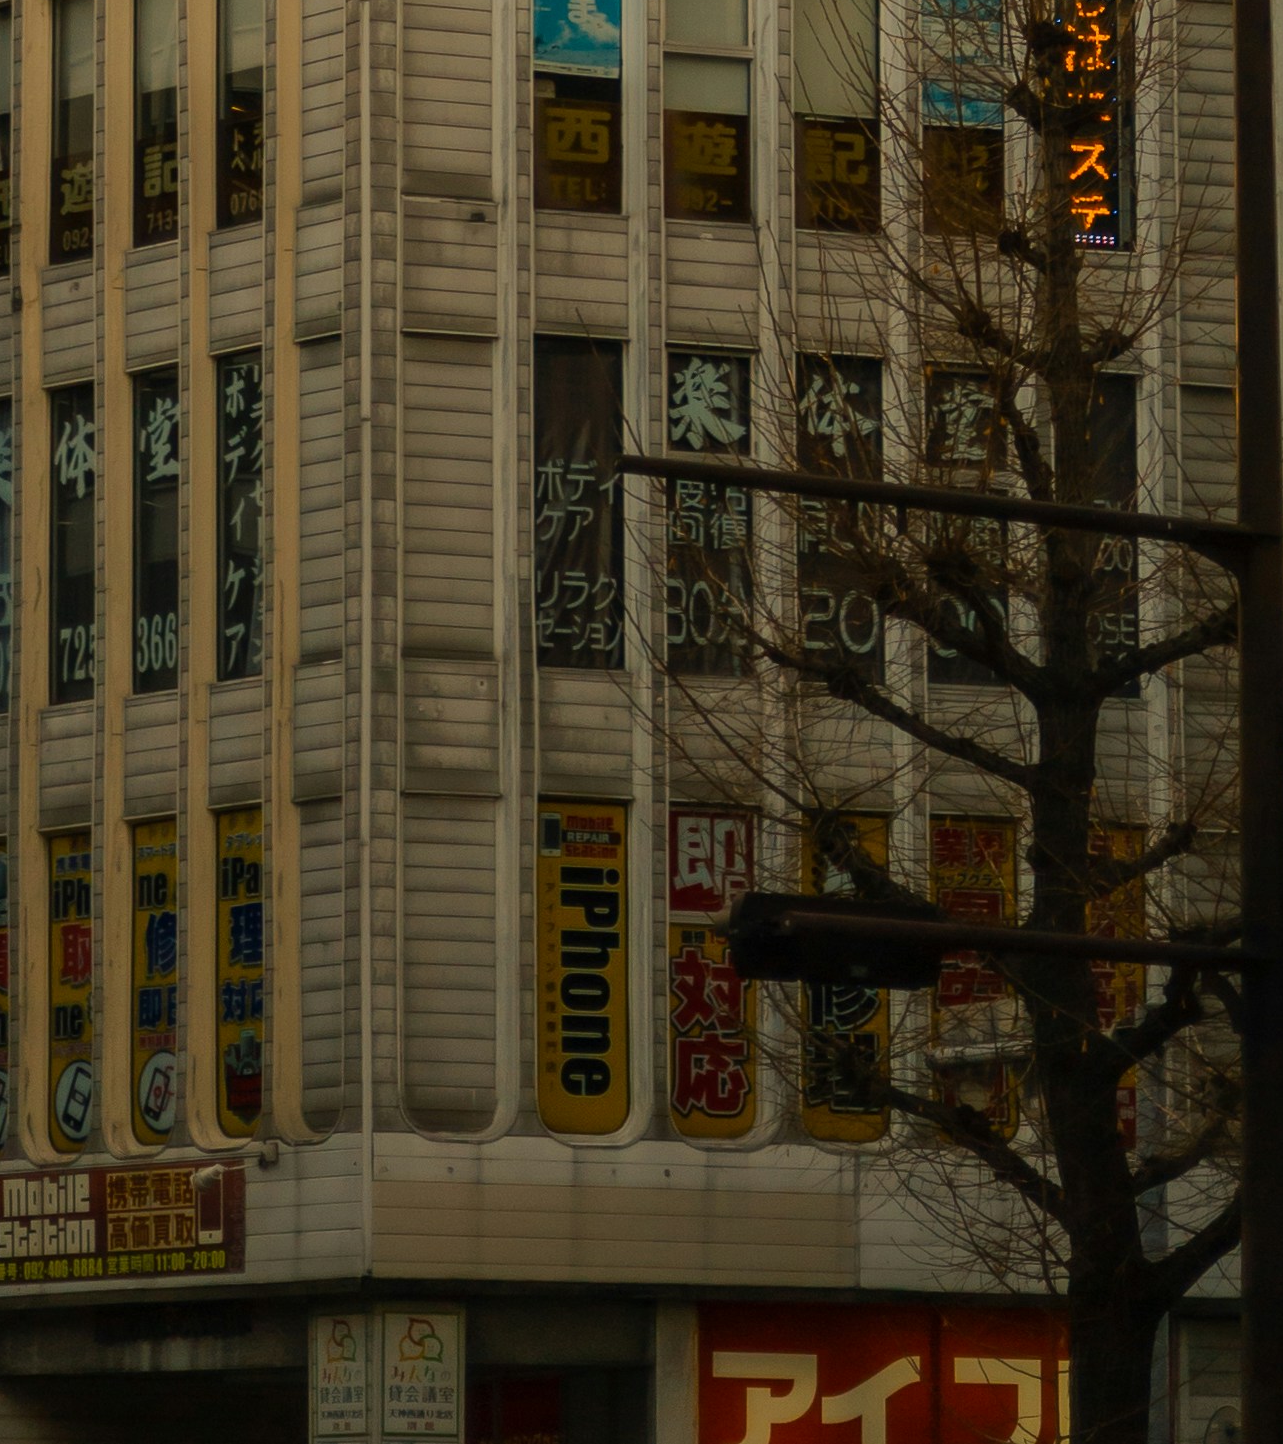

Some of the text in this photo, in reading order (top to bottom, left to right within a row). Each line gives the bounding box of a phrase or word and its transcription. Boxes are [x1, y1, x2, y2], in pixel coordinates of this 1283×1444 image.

[537, 459, 621, 505] ボディ
[537, 503, 594, 541] ケア
[537, 570, 617, 611] リラク
[567, 832, 610, 843] REPAIR
[560, 866, 620, 1097] iPhone
[671, 947, 750, 1115] 対応
[3, 1173, 90, 1217] mobile
[107, 1169, 194, 1210] 携帯電話
[108, 1211, 194, 1250] 高価買取
[389, 1385, 454, 1403] 貸会議室
[713, 1352, 1070, 1444] アイフ
